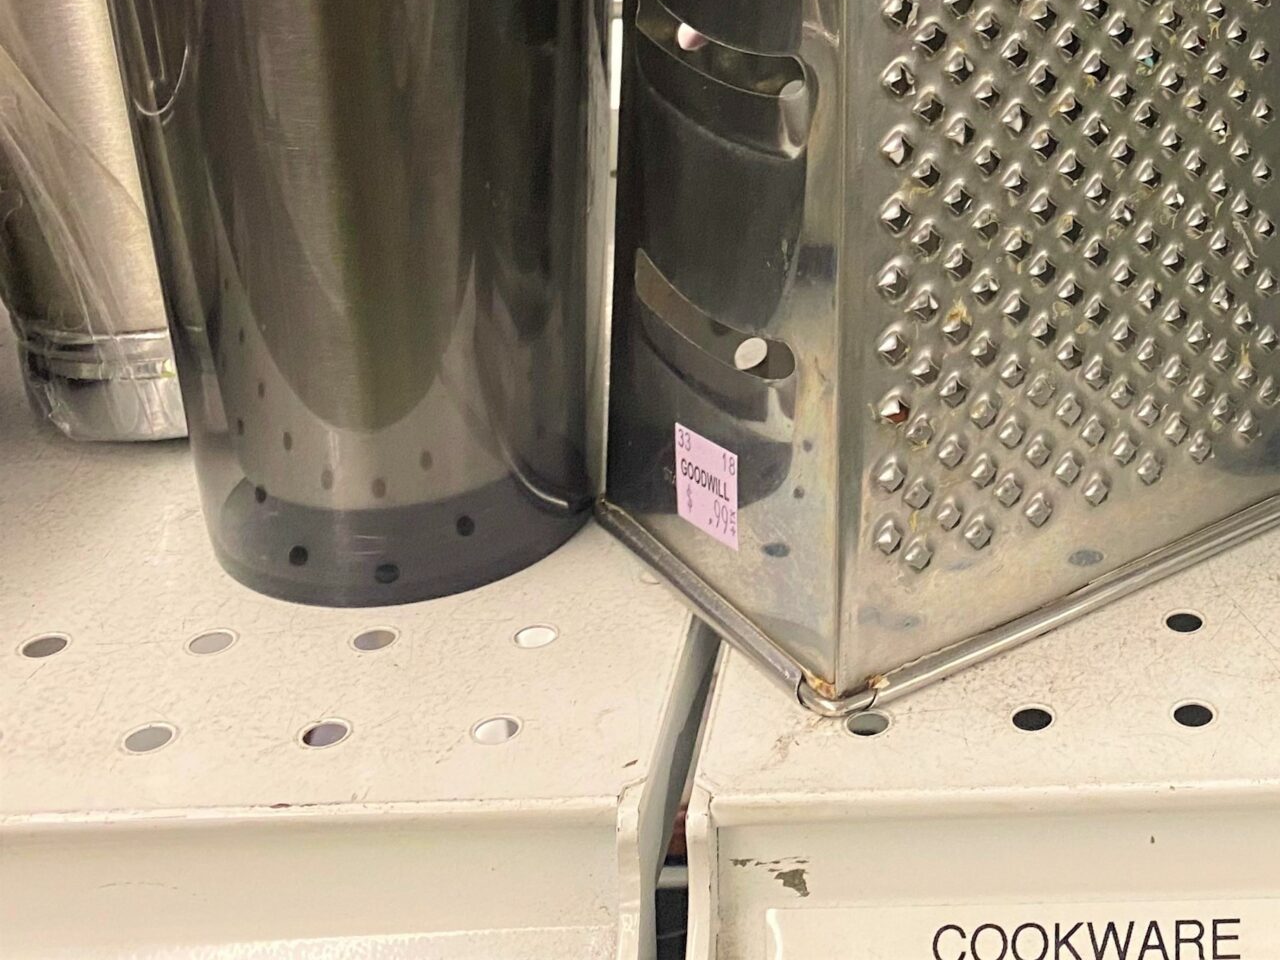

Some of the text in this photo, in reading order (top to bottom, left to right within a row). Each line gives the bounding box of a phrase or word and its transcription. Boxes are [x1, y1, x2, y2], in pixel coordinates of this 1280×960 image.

[678, 428, 736, 476] 33 18
[680, 458, 730, 502] GOODWILL
[932, 918, 1241, 960] COOKWARE
